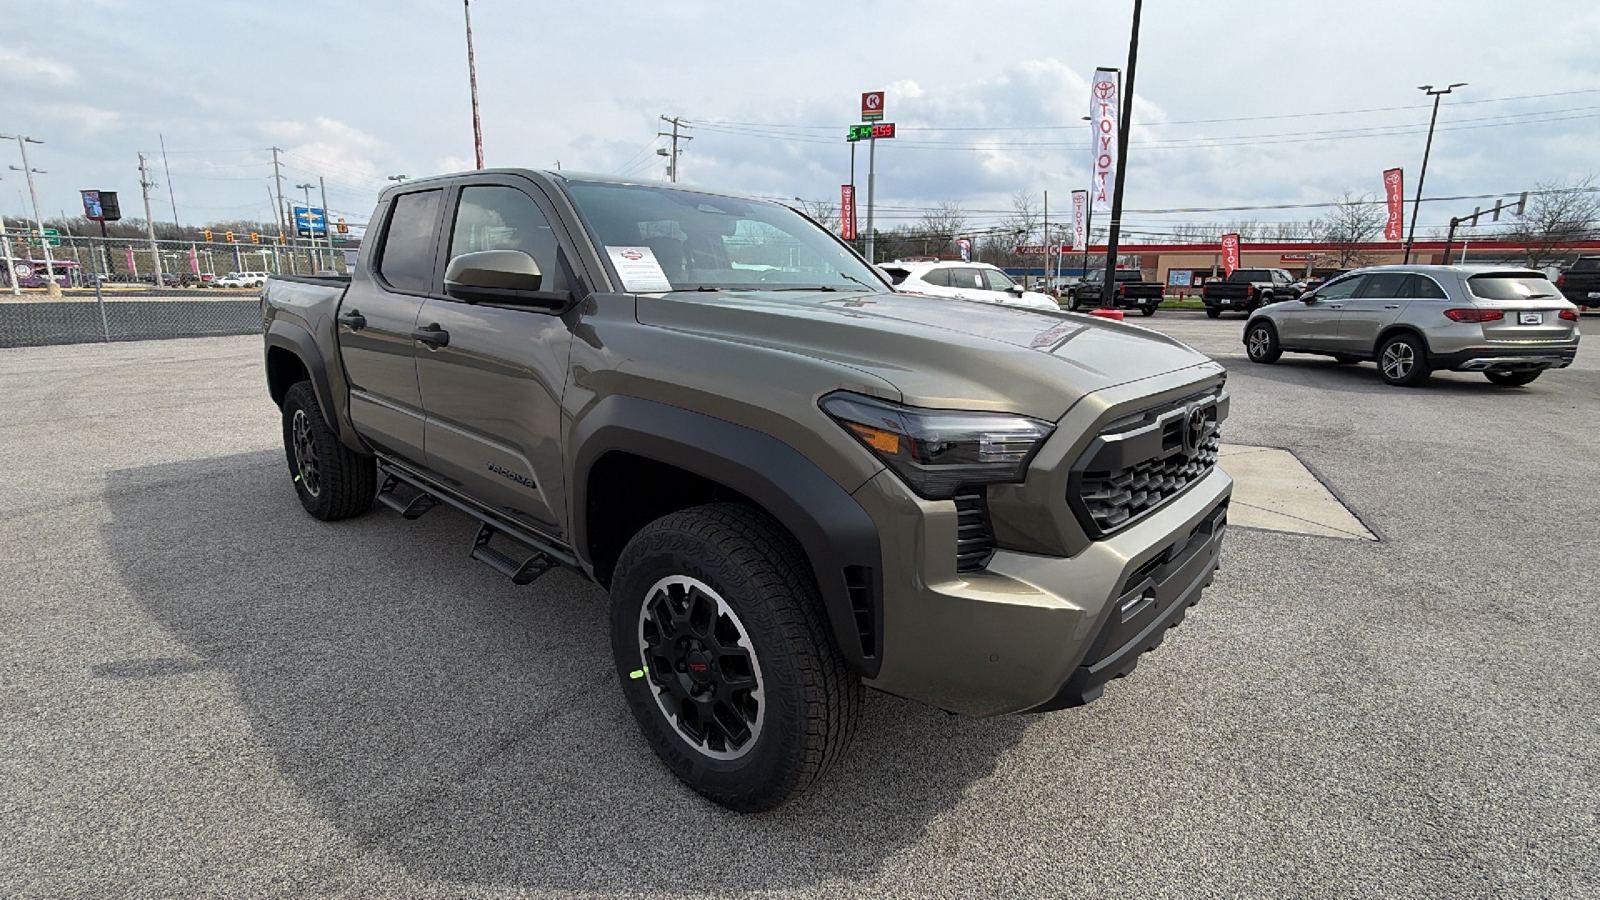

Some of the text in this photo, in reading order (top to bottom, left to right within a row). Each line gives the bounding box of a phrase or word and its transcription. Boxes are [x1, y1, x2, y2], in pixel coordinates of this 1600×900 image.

[1096, 103, 1112, 202] TOYOTA
[1075, 204, 1083, 247] TOYOTA
[486, 461, 537, 489] TACOMA
